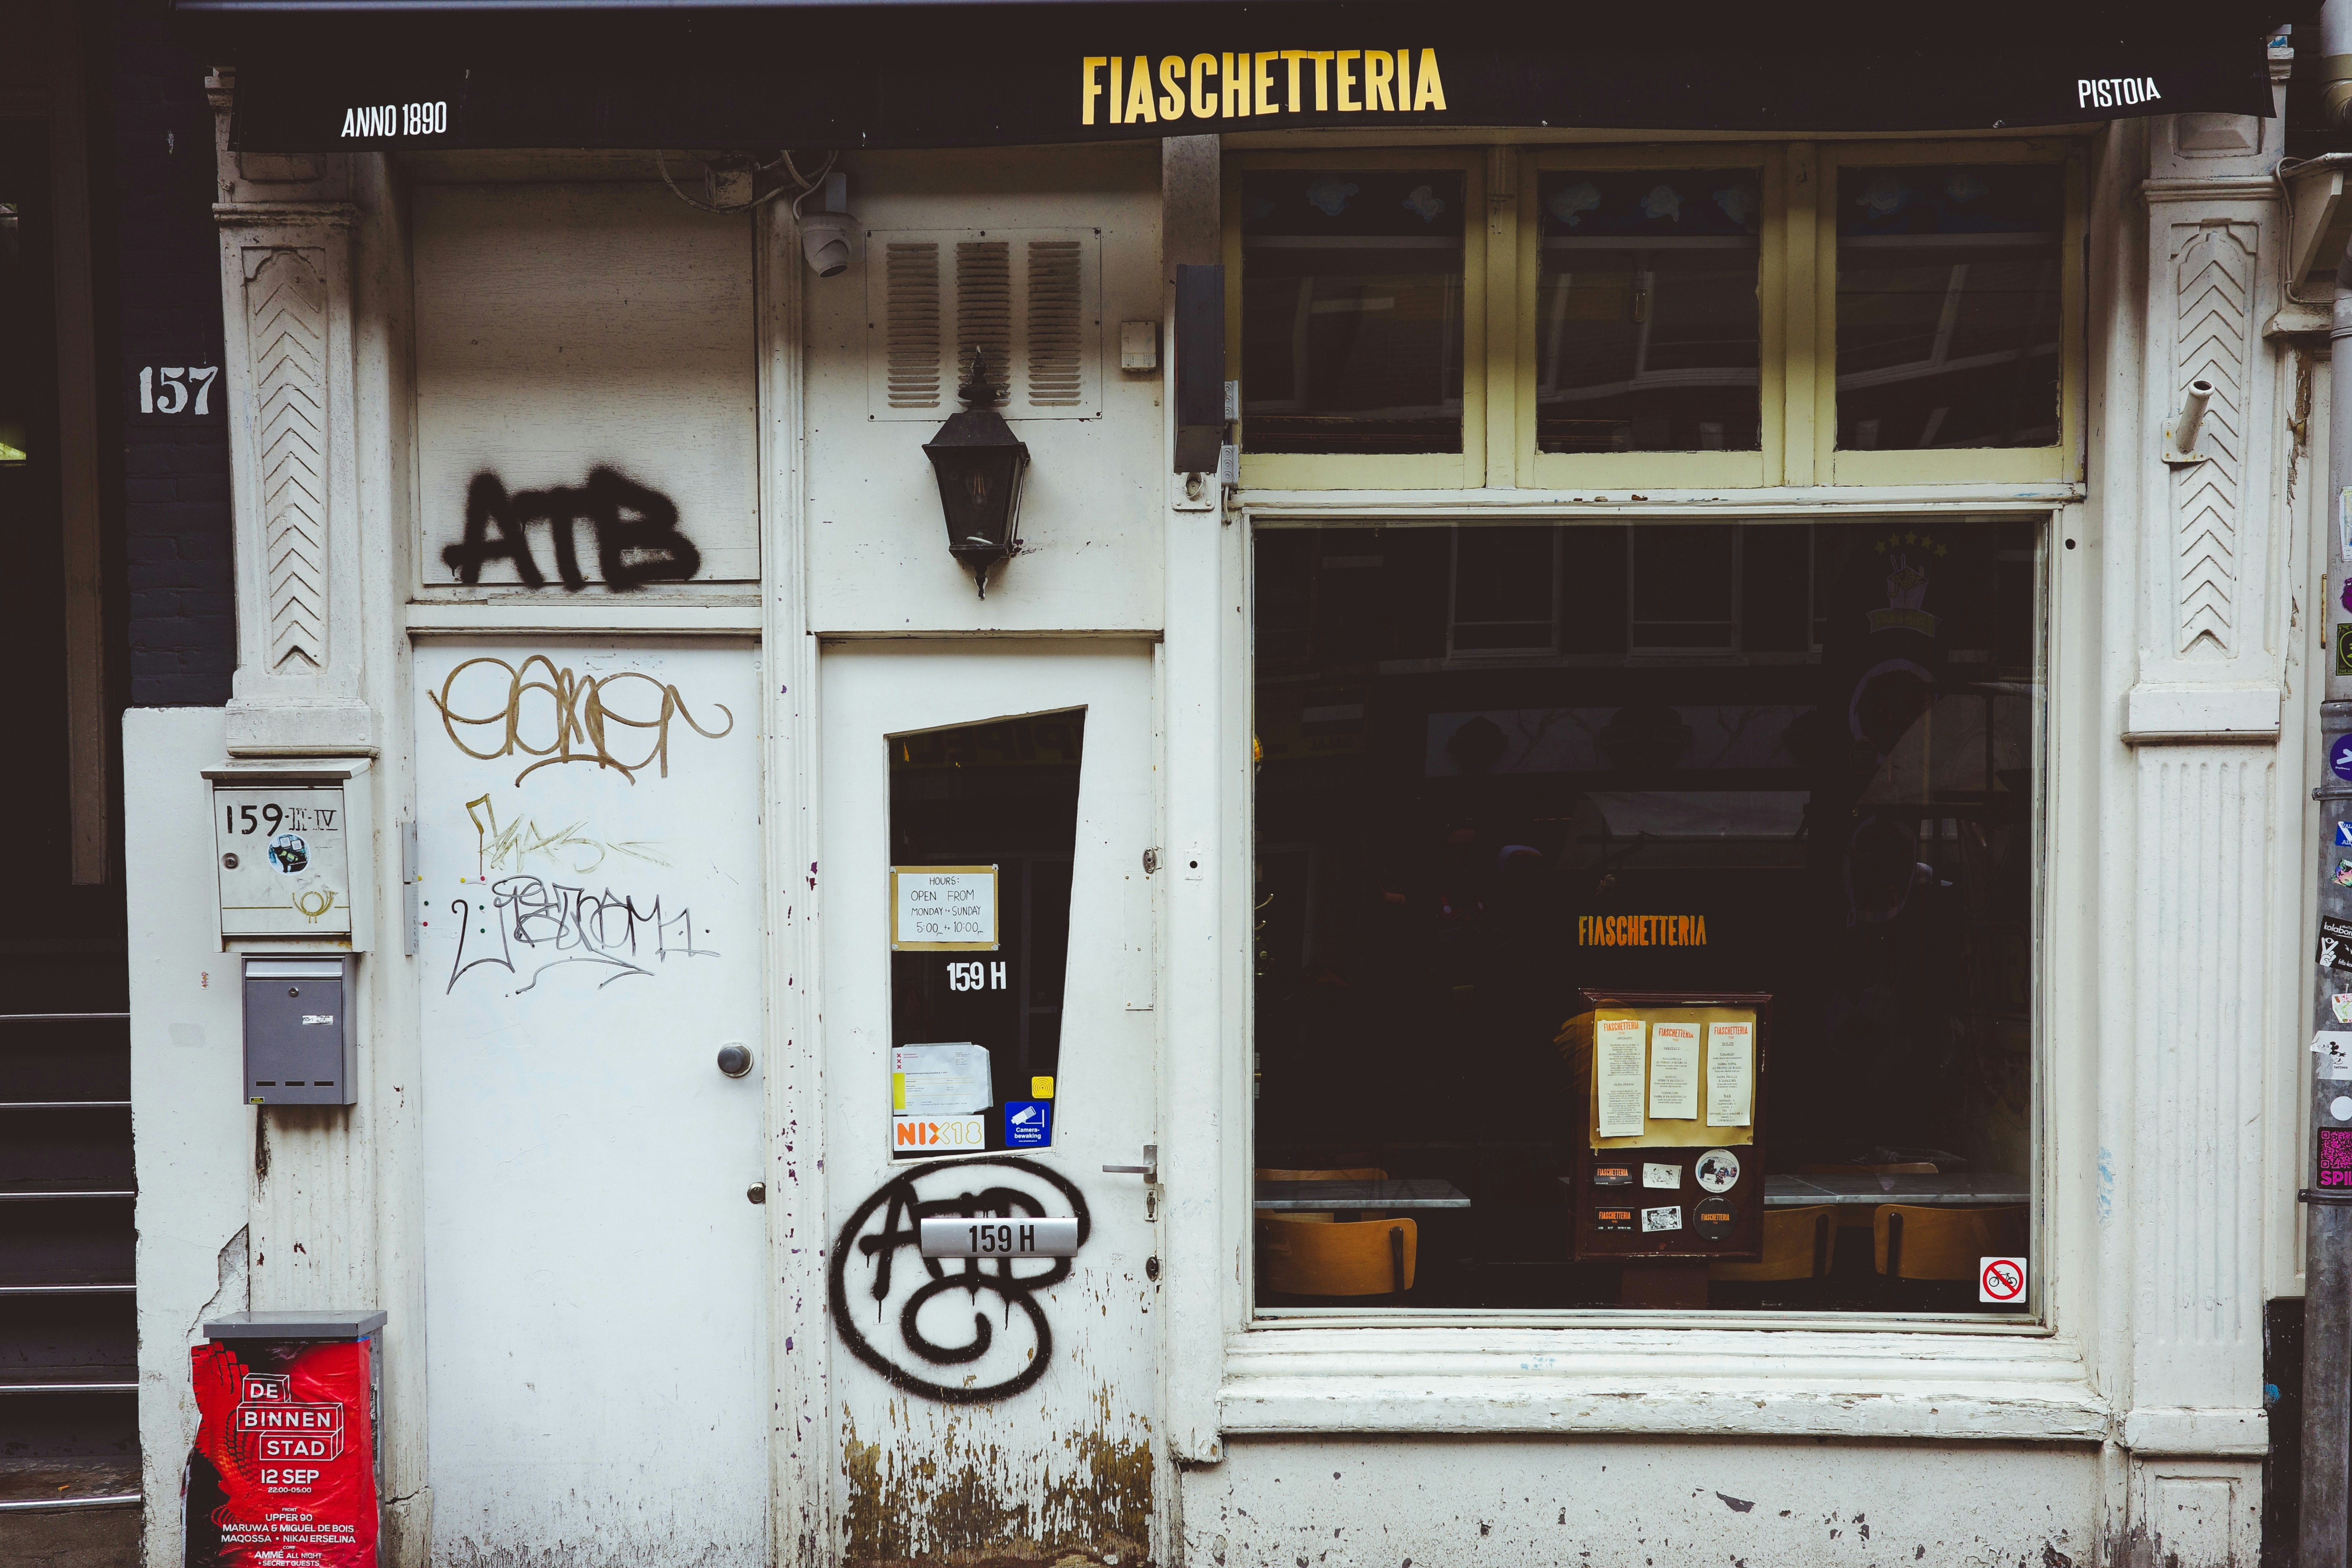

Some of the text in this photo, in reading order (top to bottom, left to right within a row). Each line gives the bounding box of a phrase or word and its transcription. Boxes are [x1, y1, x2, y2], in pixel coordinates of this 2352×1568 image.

[1082, 48, 1447, 125] FIASCHETTERIA
[2078, 77, 2161, 108] PISTOIA
[341, 101, 447, 137] ANNO 1890
[139, 366, 218, 415] 157
[930, 876, 959, 885] HOURS:
[911, 889, 974, 901] OPEN FROM
[911, 907, 943, 916] MONDAY
[952, 905, 981, 916] SUNDAY
[1579, 915, 1707, 946] FIASCHETTERIA
[947, 962, 1006, 991] 159 H
[1604, 1021, 1639, 1032] FIASCHETTERIA
[1659, 1028, 1694, 1038] FIASCHETTERIA
[1714, 1026, 1748, 1035] FIASCHETTERIA
[897, 1121, 982, 1146] NIX18
[1597, 1168, 1629, 1177] FIASCHETTERIA
[1598, 1211, 1631, 1220] FIASCHETTERIA
[969, 1224, 1036, 1253] 159 H
[250, 1383, 278, 1399] DE
[244, 1411, 330, 1427] BINNEN
[267, 1440, 325, 1456] STAD
[261, 1469, 319, 1484] 12 SEP
[221, 1535, 272, 1543] MAQOSSA
[310, 1535, 356, 1543] ERSELINA
[254, 1549, 284, 1559] AMMÉ
